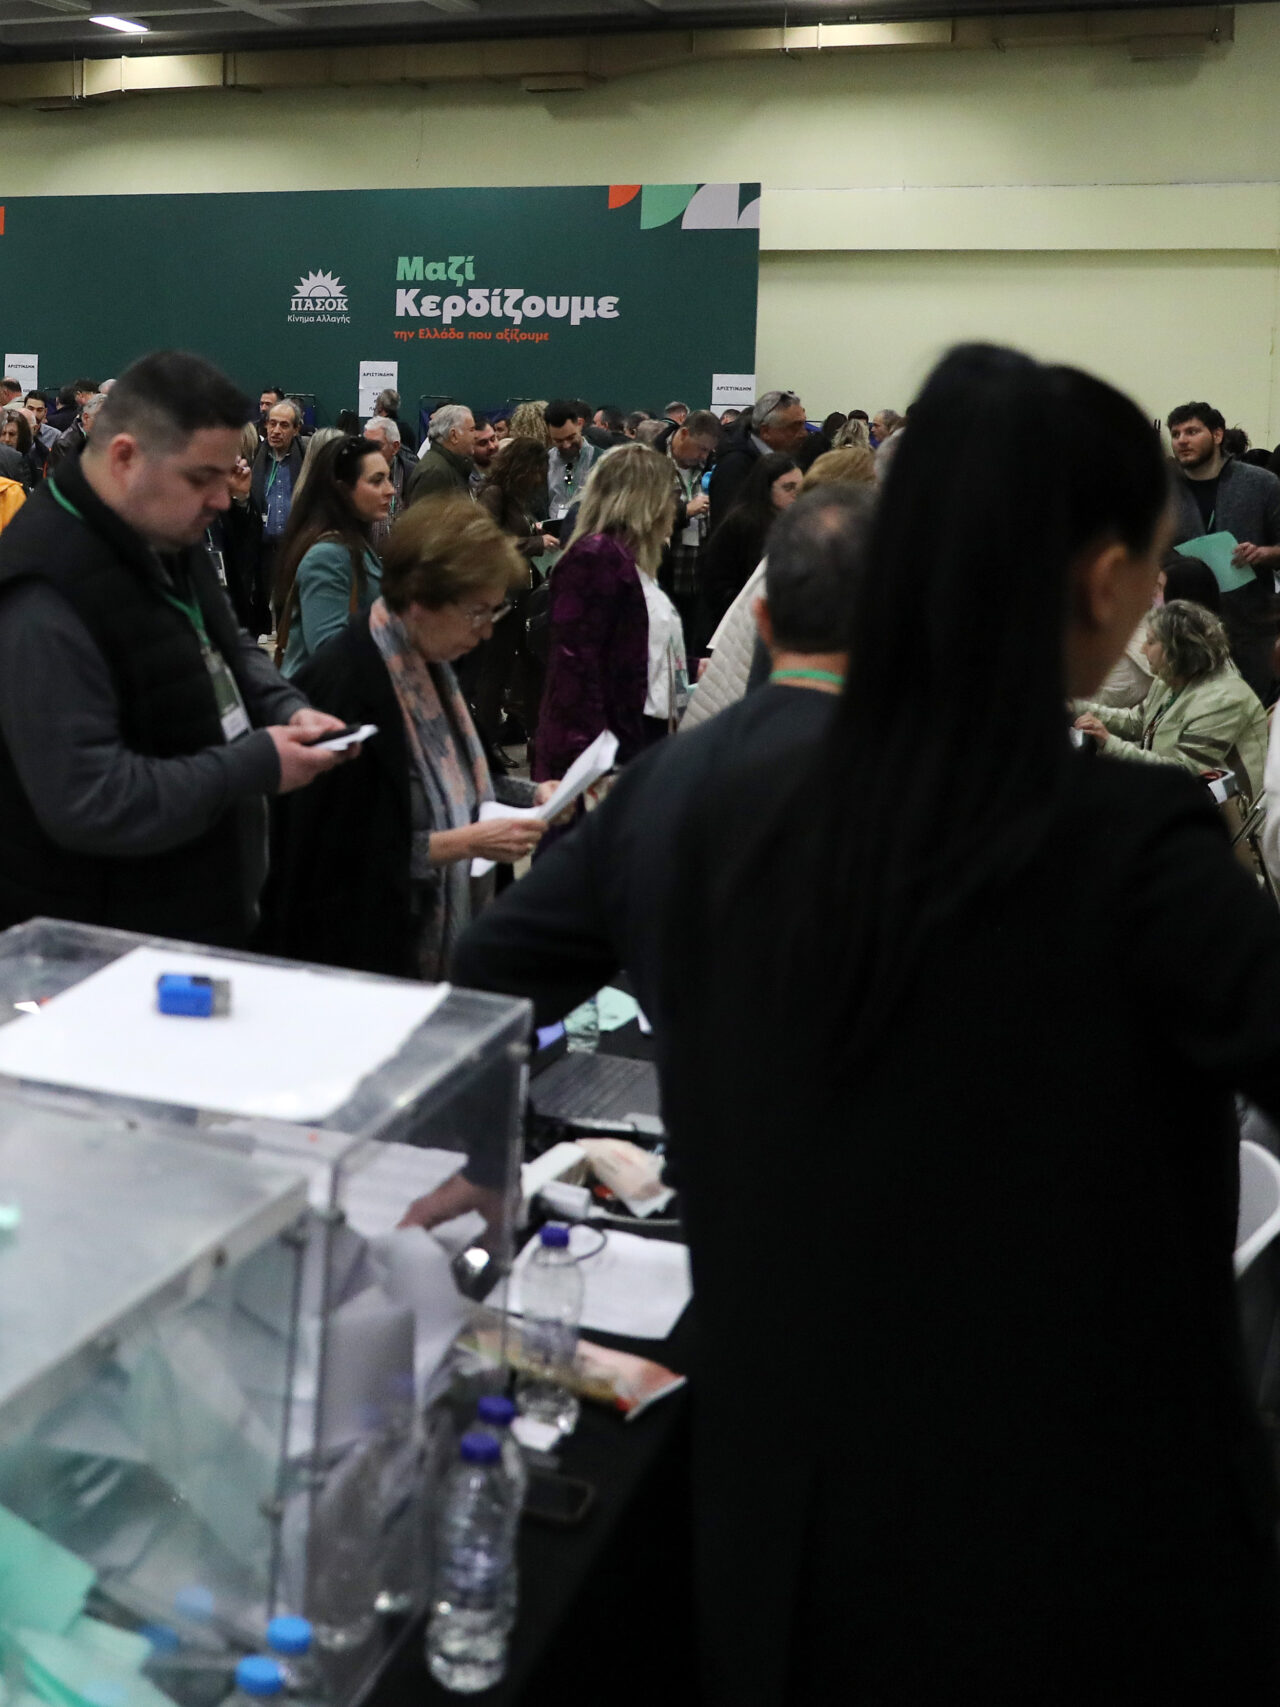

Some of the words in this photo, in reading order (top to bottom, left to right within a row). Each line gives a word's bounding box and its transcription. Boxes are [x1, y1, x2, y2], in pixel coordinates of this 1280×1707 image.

[396, 255, 475, 287] Μαζί
[290, 298, 349, 311] ΠΑΣΟΚ
[395, 288, 620, 325] Κερδίζουμε
[287, 314, 315, 323] Κίνημα
[316, 314, 350, 323] Αλλαγής
[393, 330, 415, 342] την
[418, 328, 464, 339] Ελλάδα
[468, 330, 492, 340] που
[495, 328, 550, 343] αξίζουμε
